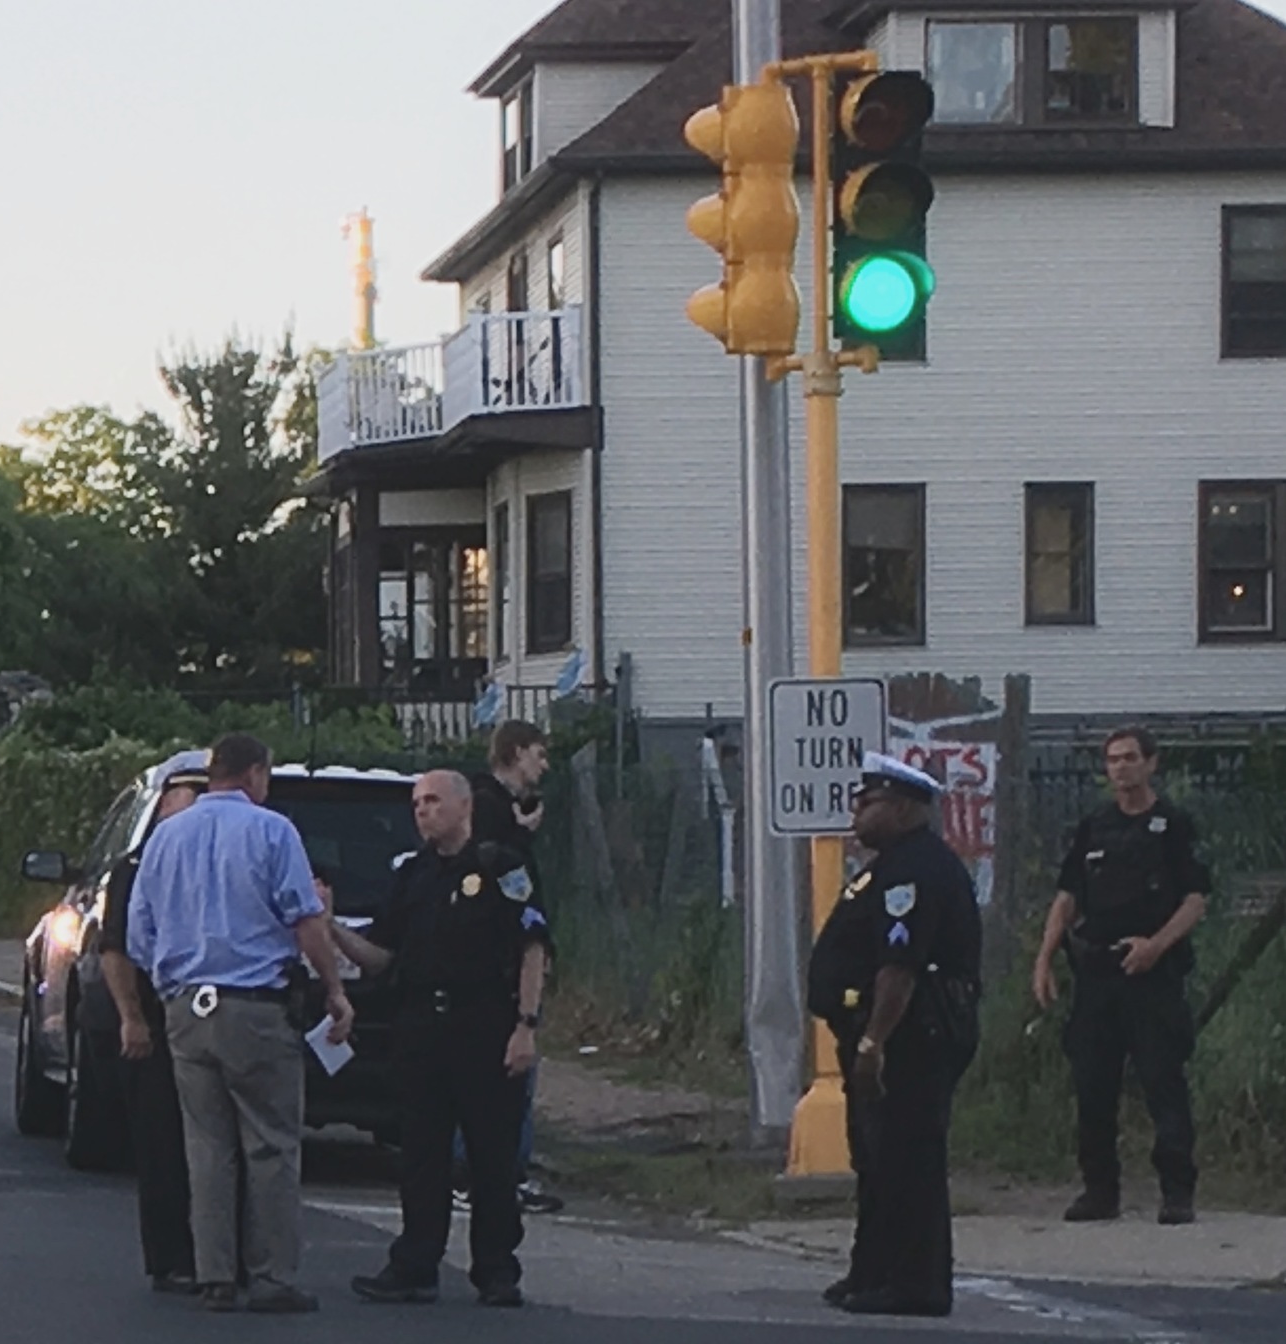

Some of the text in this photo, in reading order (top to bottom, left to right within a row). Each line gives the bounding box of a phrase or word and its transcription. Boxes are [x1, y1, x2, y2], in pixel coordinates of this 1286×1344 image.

[806, 690, 848, 727] NO
[795, 737, 863, 769] TURN
[781, 784, 814, 814] ON
